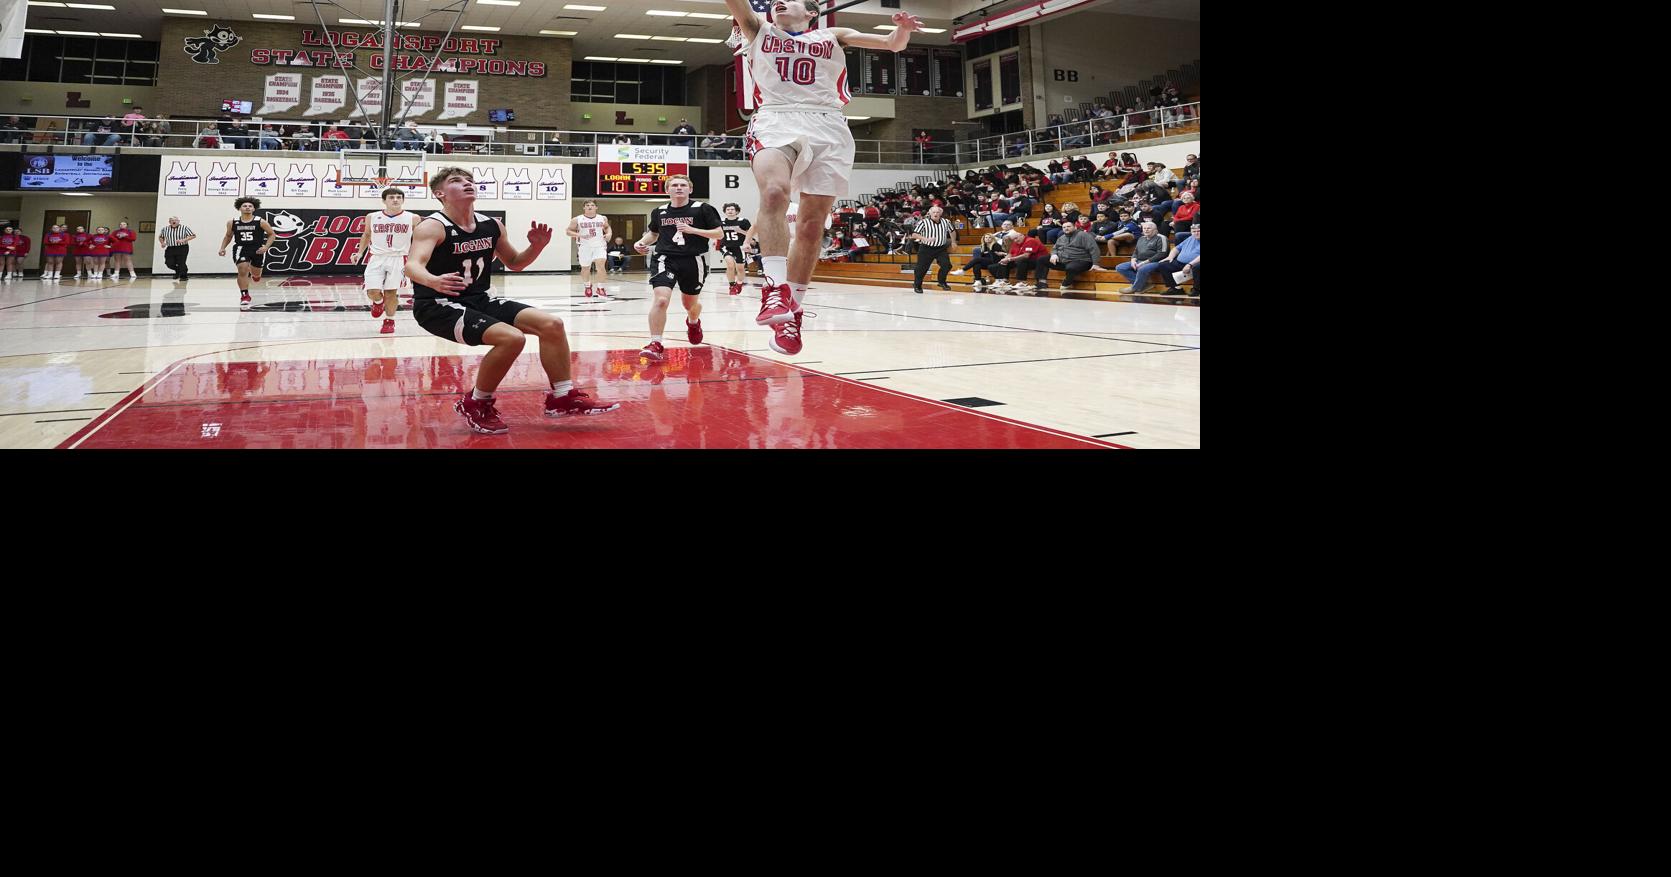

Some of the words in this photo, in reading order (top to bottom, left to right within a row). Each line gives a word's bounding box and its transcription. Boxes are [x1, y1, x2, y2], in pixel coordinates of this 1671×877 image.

[302, 30, 499, 54] LOGANSPORT
[761, 34, 834, 59] CASTON
[251, 48, 354, 68] STATE
[369, 53, 546, 77] CHAMPIONS
[776, 57, 816, 85] 10
[1054, 69, 1079, 82] BB
[66, 92, 91, 108] L
[616, 111, 634, 125] L
[632, 163, 665, 174] 5:35
[611, 181, 625, 192] 10
[639, 183, 648, 191] 2
[725, 174, 740, 189] B
[314, 215, 367, 234] LOG
[373, 223, 409, 233] CASTON
[660, 216, 694, 226] LOGAN
[240, 231, 254, 241] 35
[386, 234, 394, 248] 4
[672, 229, 686, 246] 4
[725, 231, 739, 241] 15
[452, 237, 493, 255] LOGAN
[461, 256, 485, 287] 11
